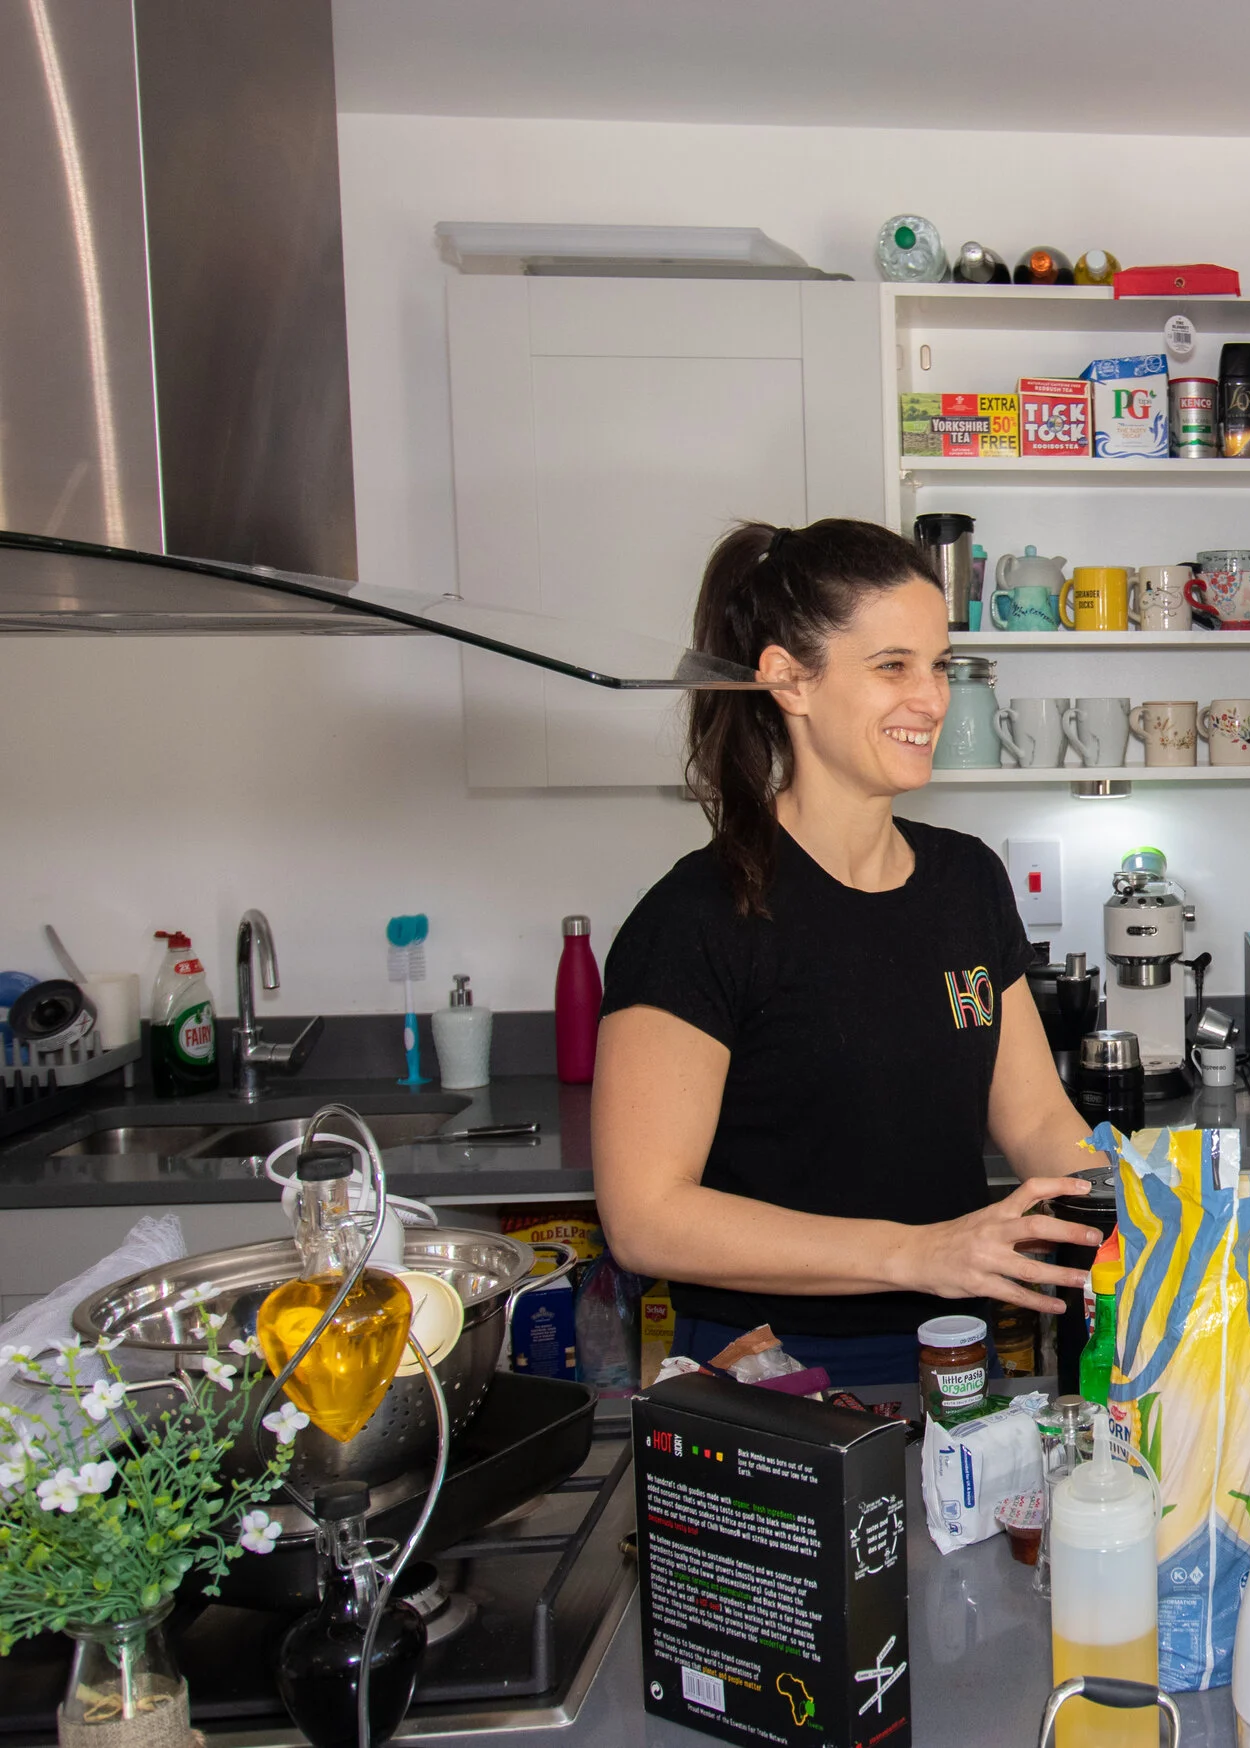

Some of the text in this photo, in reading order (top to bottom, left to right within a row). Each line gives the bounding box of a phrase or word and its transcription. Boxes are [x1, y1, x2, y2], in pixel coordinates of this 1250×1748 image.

[980, 398, 1016, 411] EXTRA
[1112, 389, 1152, 420] PG
[1181, 400, 1212, 408] KENCO
[1024, 403, 1085, 422] TICK
[932, 418, 989, 432] YORKSHIRE
[1024, 423, 1085, 442] TOCK
[951, 432, 970, 442] TEA
[980, 436, 1016, 450] FREE
[185, 1024, 212, 1047] FAIRY
[530, 1230, 554, 1242] OLD
[555, 1226, 570, 1238] EL
[942, 1370, 982, 1384] little pasta
[942, 1379, 984, 1394] organics
[1108, 1418, 1131, 1443] ORN
[646, 1429, 682, 1456] a HOT STORY
[939, 1446, 956, 1454] 1
[738, 1449, 749, 1457] Black
[776, 1459, 787, 1467] born
[738, 1458, 747, 1466] love
[756, 1464, 771, 1472] chillies
[791, 1471, 799, 1479] love
[647, 1473, 653, 1481] We
[654, 1476, 675, 1488] handcraft
[676, 1483, 687, 1492] chilli
[688, 1488, 705, 1497] goodies
[706, 1493, 719, 1501] made
[753, 1504, 765, 1512] fresh
[767, 1509, 795, 1520] ingredients
[647, 1485, 659, 1493] added
[697, 1500, 706, 1508] why
[707, 1502, 718, 1512] they
[720, 1506, 733, 1515] taste
[756, 1514, 765, 1523] The
[766, 1518, 779, 1526] black
[781, 1522, 799, 1531] mamba
[807, 1528, 816, 1536] one
[662, 1499, 673, 1507] most
[675, 1503, 697, 1515] dangerous
[699, 1511, 714, 1520] snakes
[722, 1516, 736, 1526] Africa
[737, 1521, 746, 1529] and
[757, 1527, 772, 1535] strike
[792, 1534, 808, 1545] deadly
[880, 1517, 888, 1528] good
[867, 1528, 888, 1544] looks good
[878, 1539, 886, 1550] good
